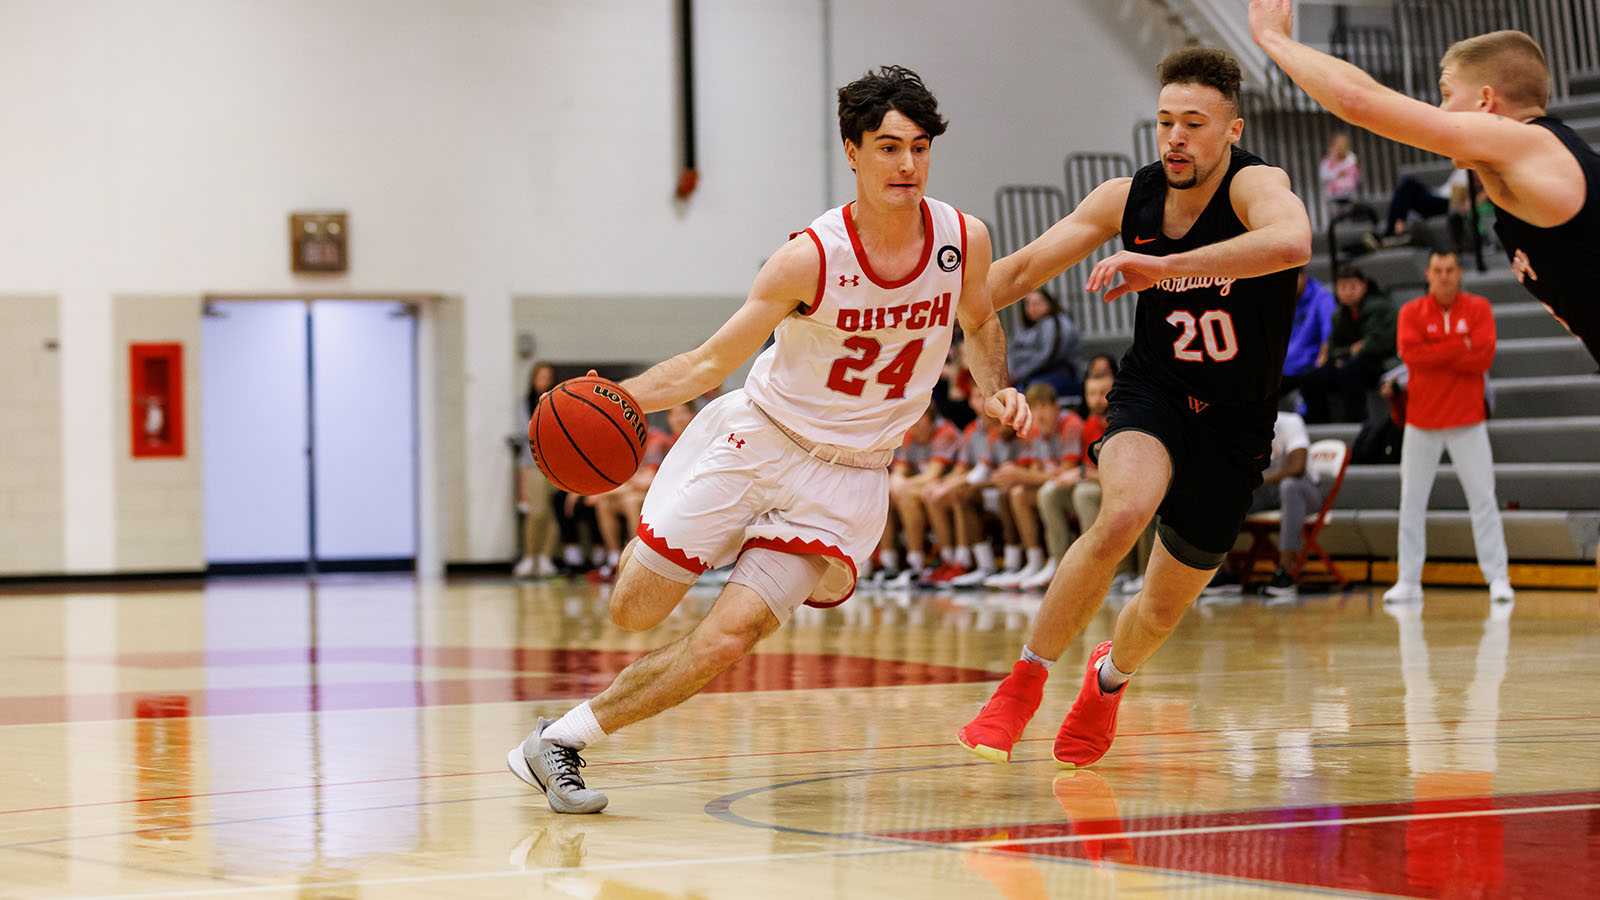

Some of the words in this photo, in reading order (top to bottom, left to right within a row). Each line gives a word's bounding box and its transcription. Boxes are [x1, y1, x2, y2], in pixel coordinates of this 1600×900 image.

[836, 292, 952, 333] DUTCH
[1165, 309, 1239, 363] 20
[824, 335, 926, 400] 24
[593, 384, 648, 449] Wilson
